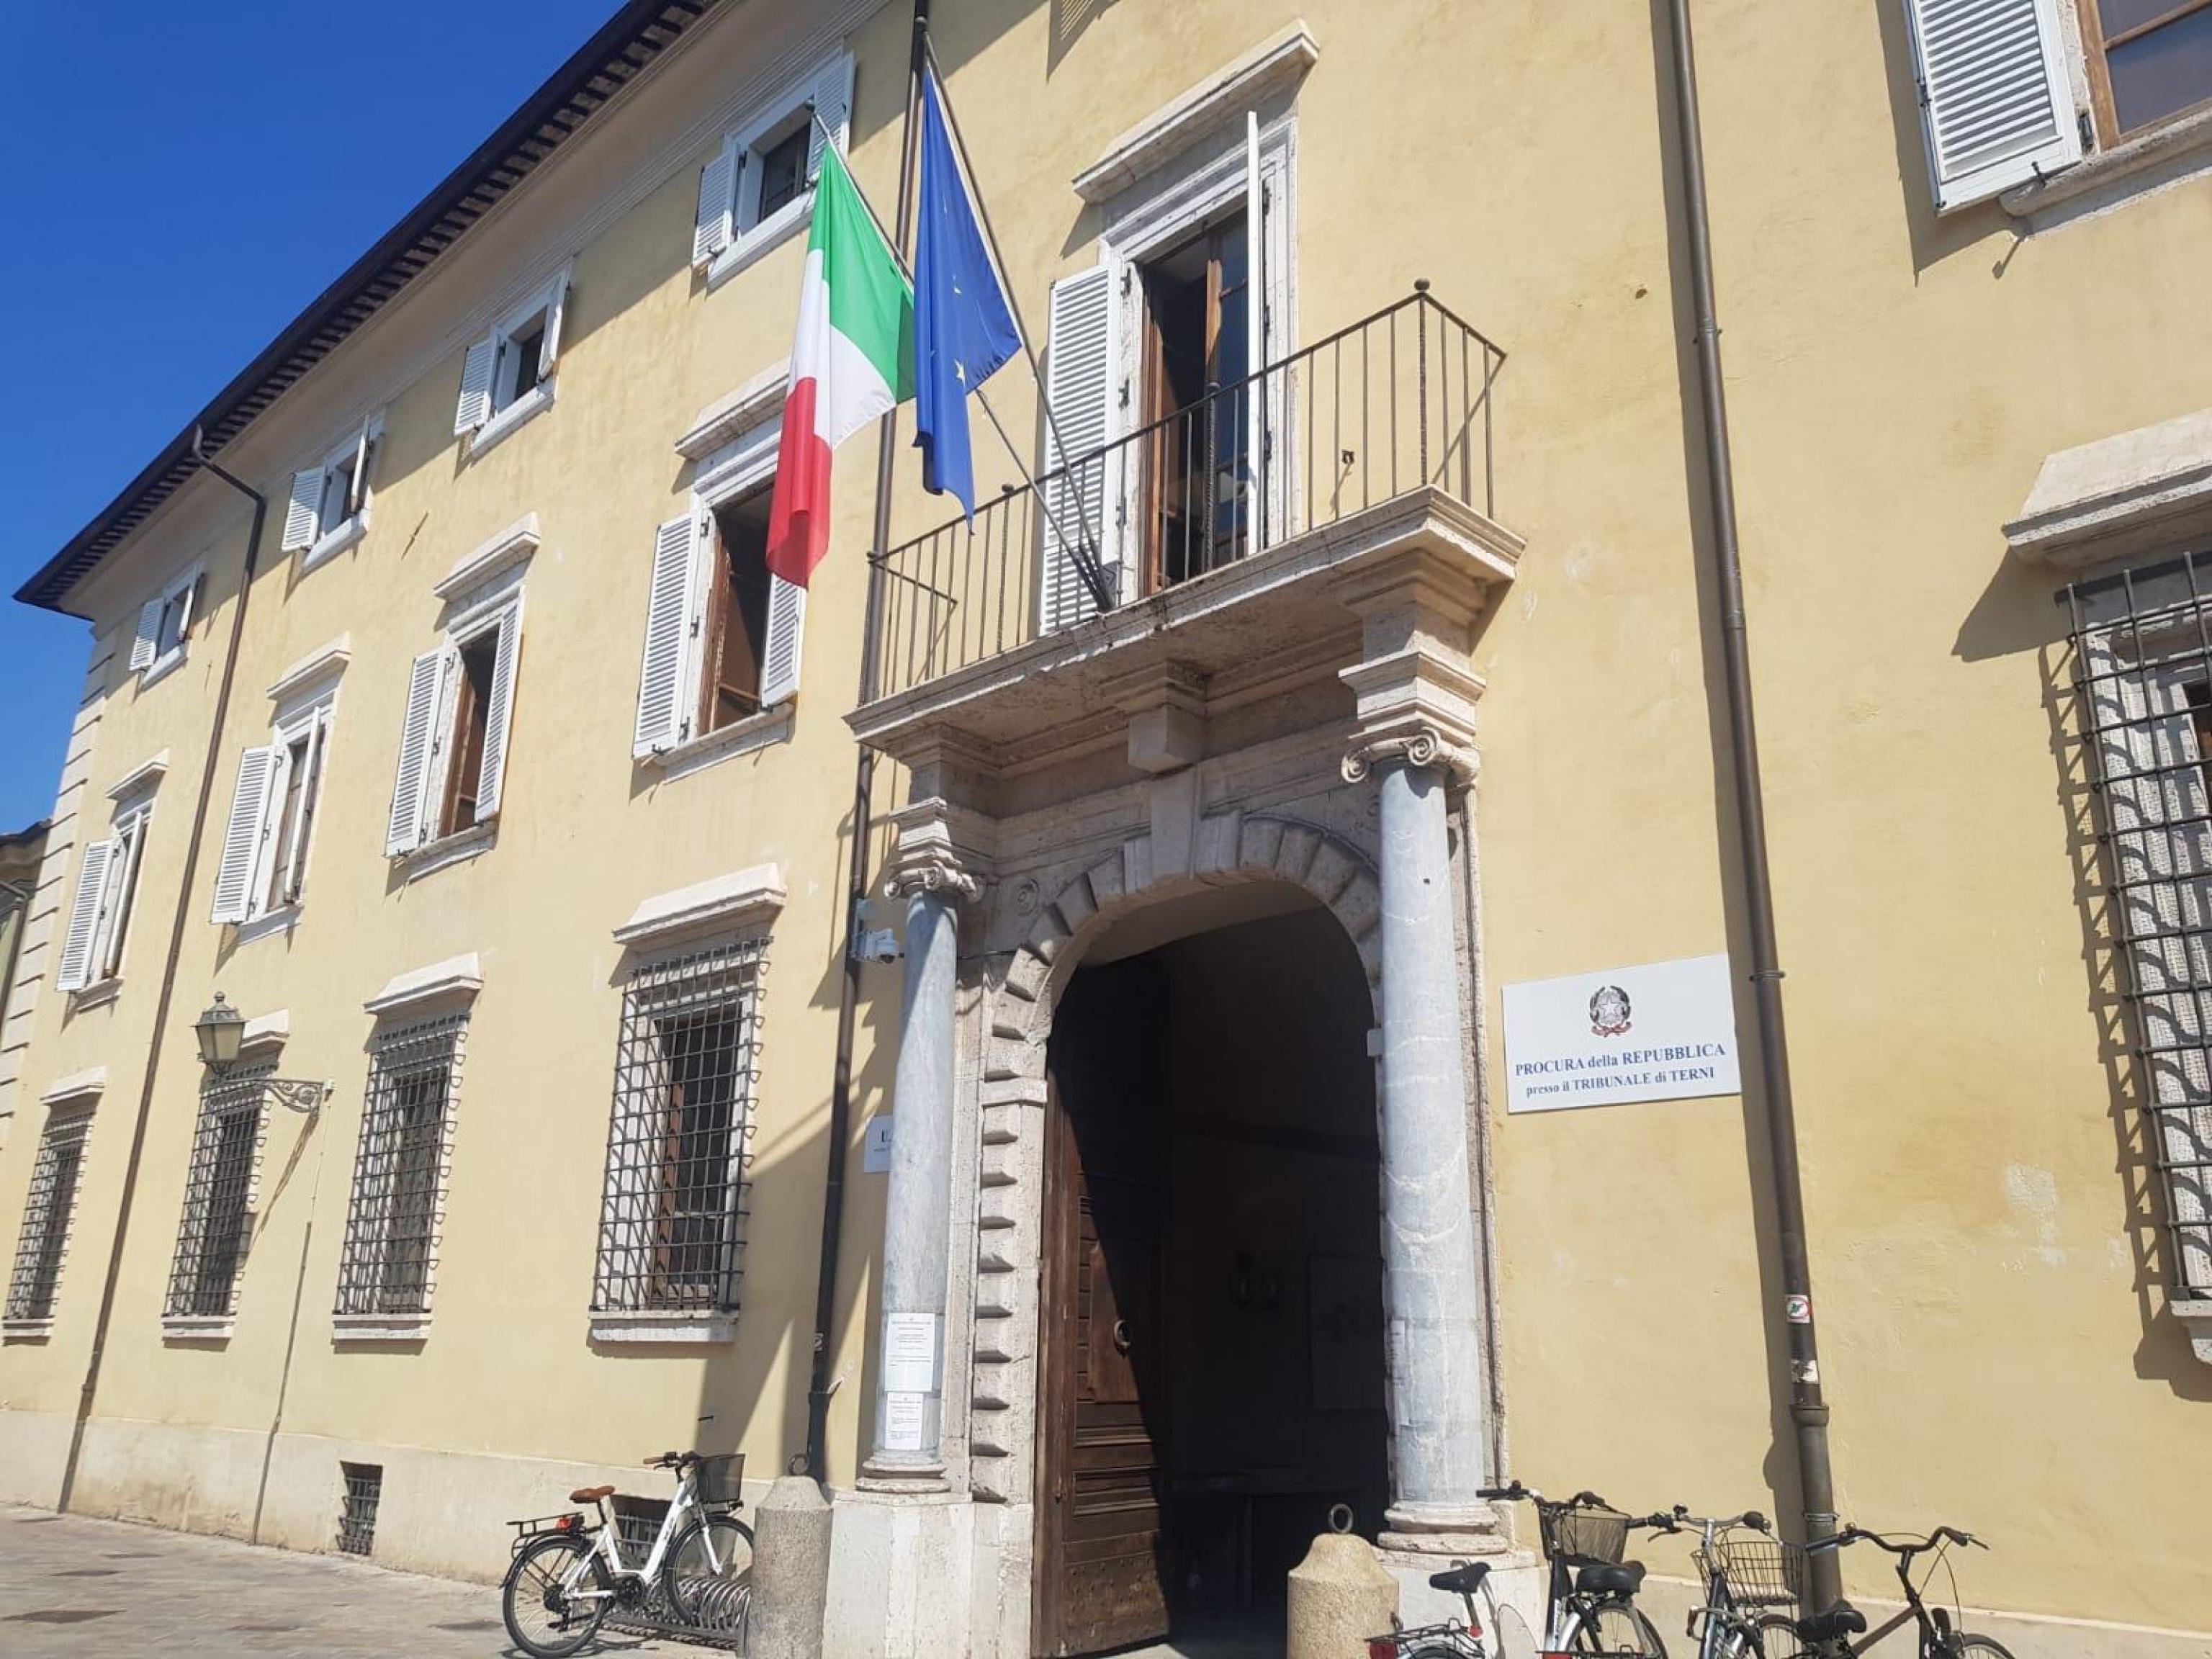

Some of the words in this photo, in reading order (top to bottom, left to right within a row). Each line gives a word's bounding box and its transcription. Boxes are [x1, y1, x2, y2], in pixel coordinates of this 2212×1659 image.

[1515, 1057, 1585, 1076] PROCURA
[1588, 1053, 1619, 1069] della
[1622, 1043, 1726, 1065] REPUBBLICA
[1526, 1082, 1560, 1098] presso
[1563, 1082, 1570, 1092] il
[1572, 1072, 1651, 1091] TRIBUNALE
[1655, 1071, 1667, 1083] di
[1671, 1066, 1714, 1082] TERNI
